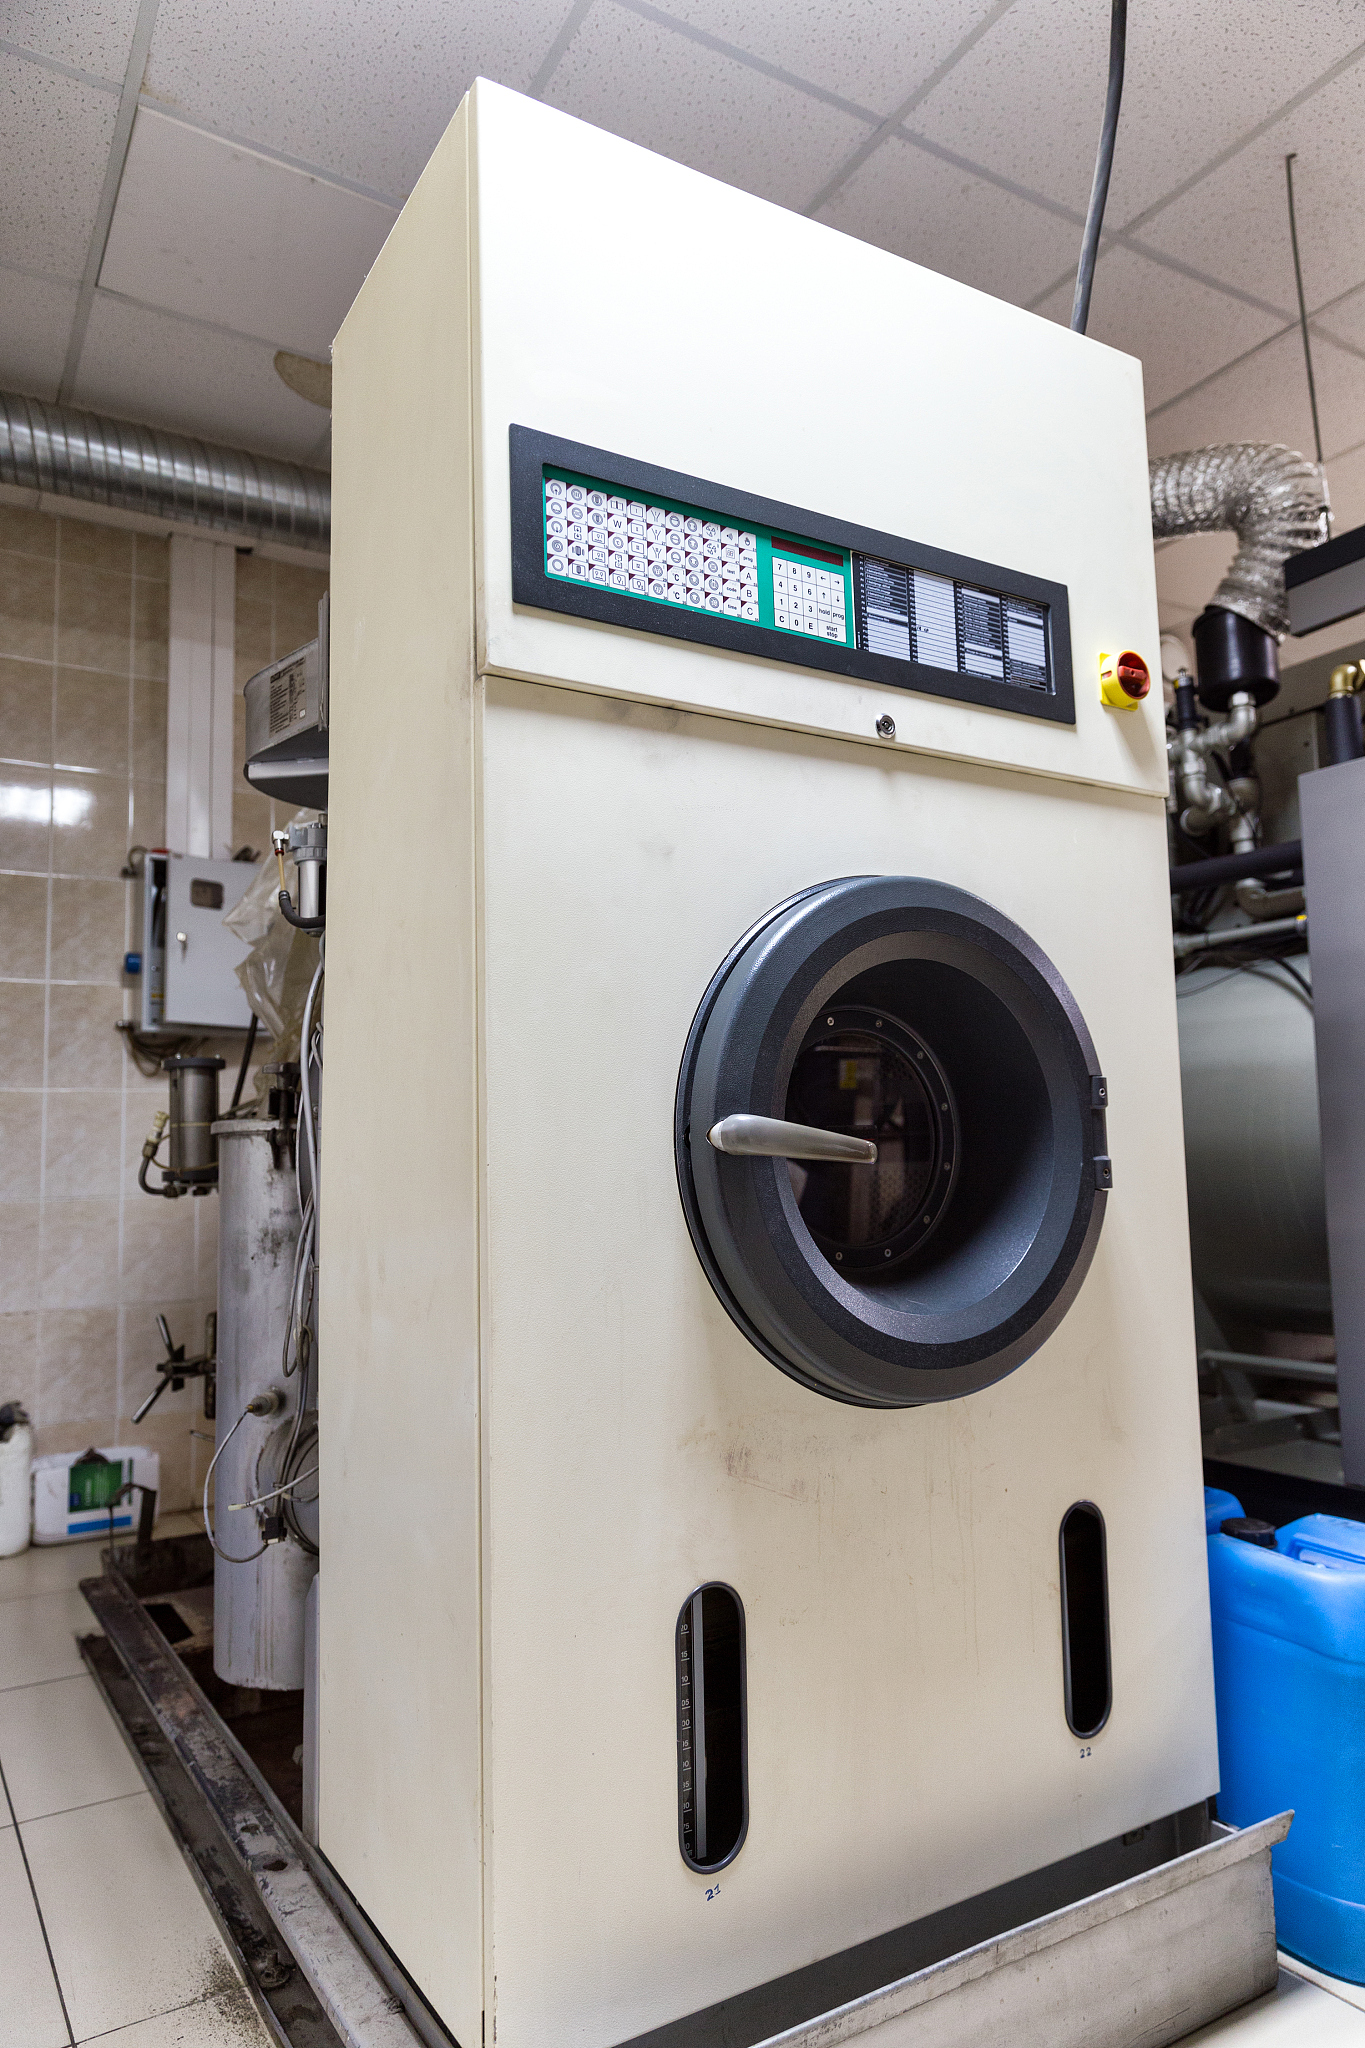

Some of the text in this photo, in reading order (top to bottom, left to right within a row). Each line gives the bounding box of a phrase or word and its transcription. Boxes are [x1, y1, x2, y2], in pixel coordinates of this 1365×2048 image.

[613, 520, 622, 528] W
[819, 606, 830, 616] hold
[833, 612, 844, 620] prog
[1080, 1747, 1092, 1758] 22
[705, 1883, 721, 1902] 21
